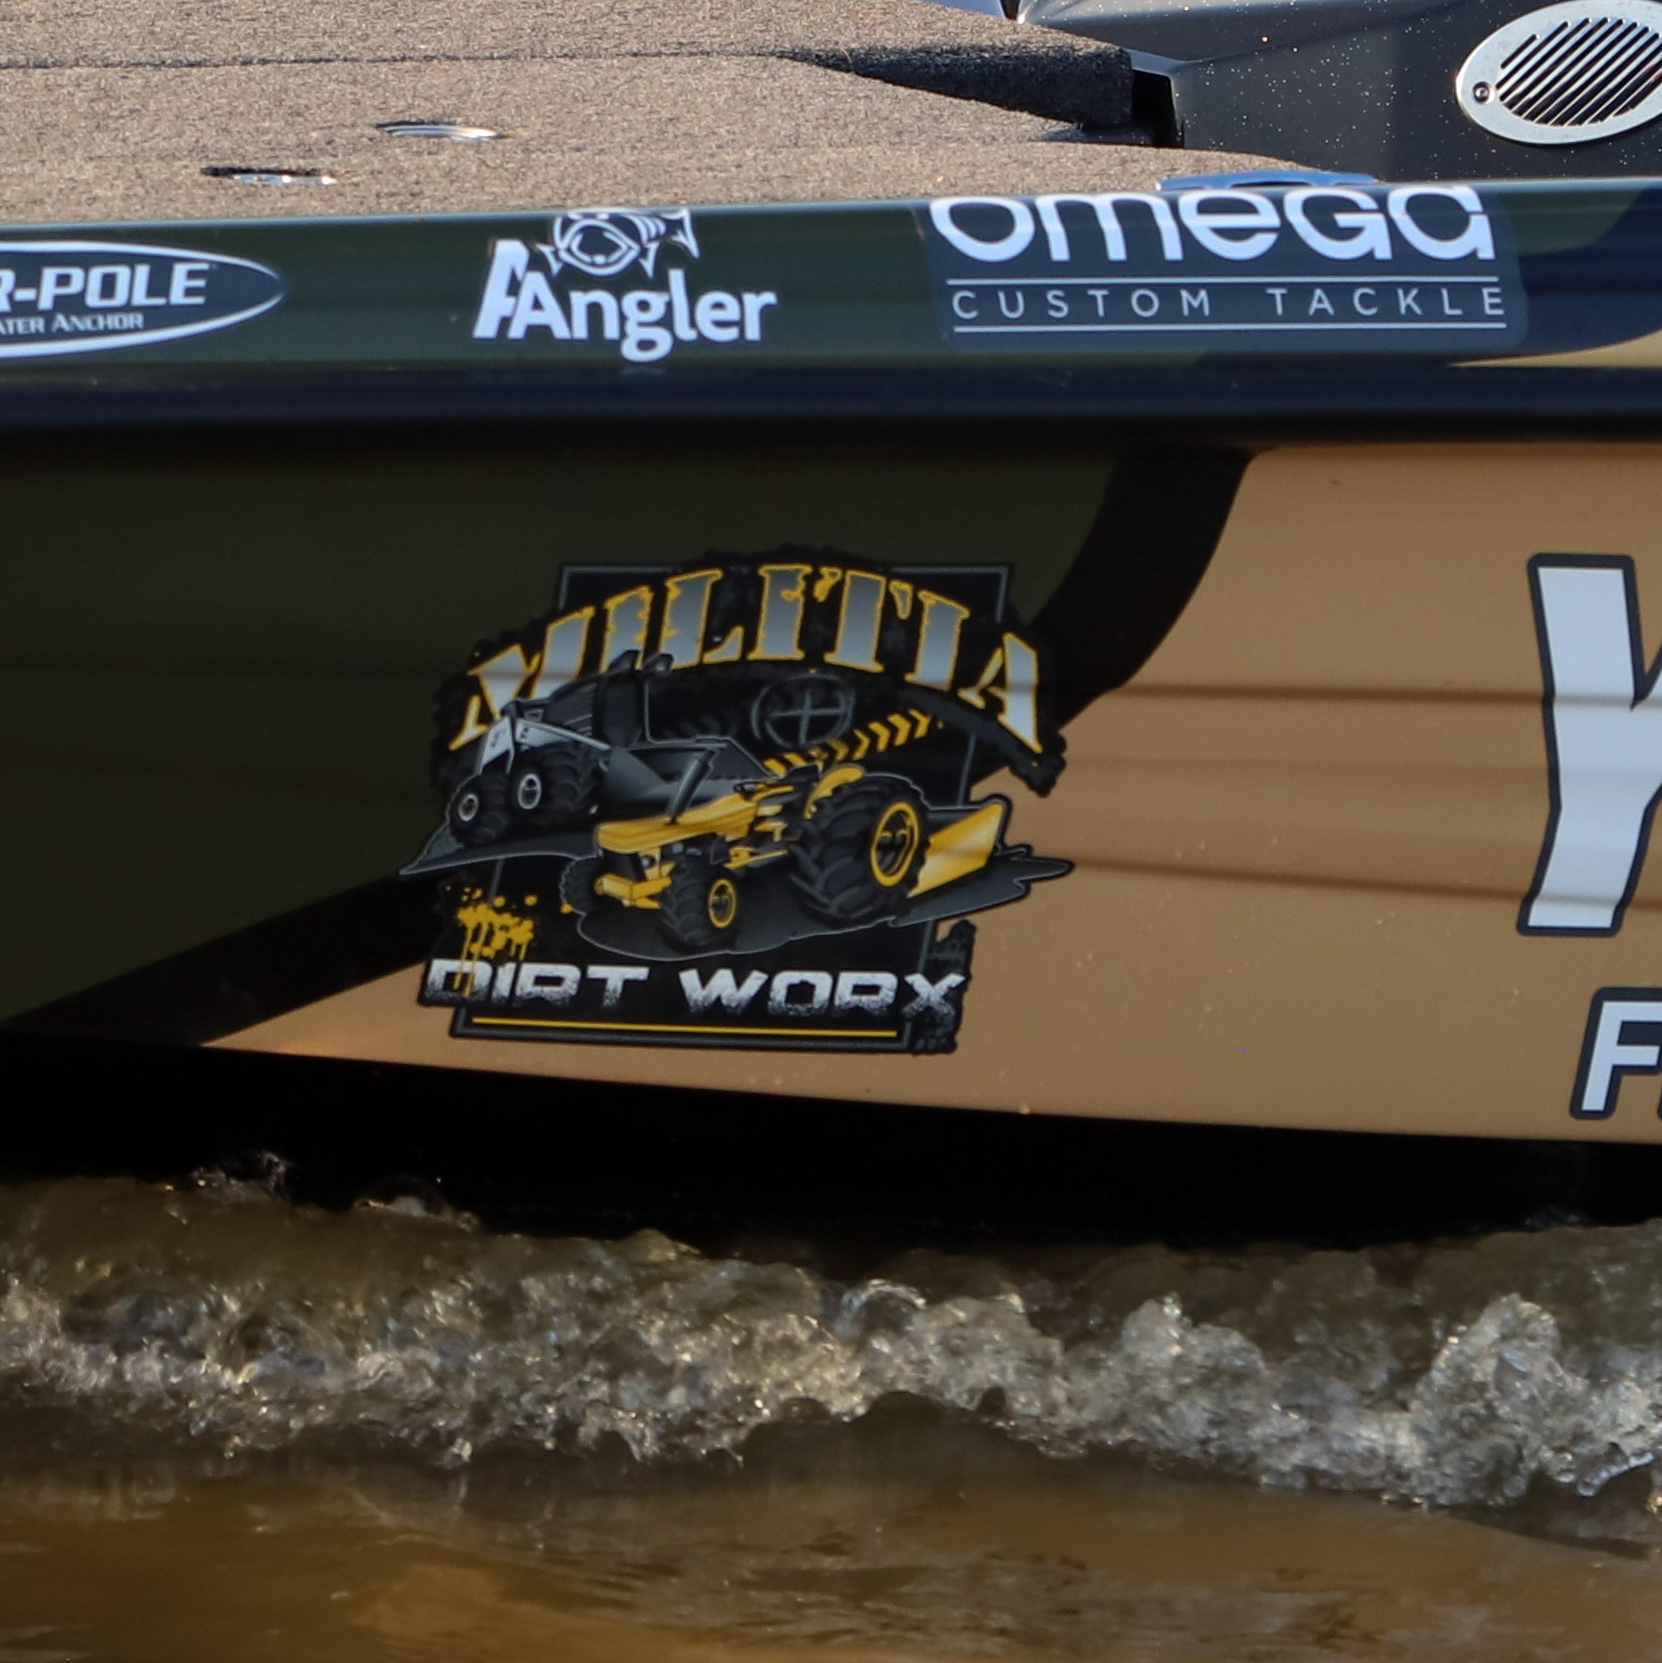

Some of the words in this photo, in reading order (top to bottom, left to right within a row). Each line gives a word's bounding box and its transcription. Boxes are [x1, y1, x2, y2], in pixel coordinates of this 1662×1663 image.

[952, 287, 1211, 320] CUSTOM
[1267, 286, 1505, 317] TACKLE
[52, 312, 145, 333] ANCHOR
[424, 958, 651, 1005] DIRT
[677, 969, 967, 1018] WORX
